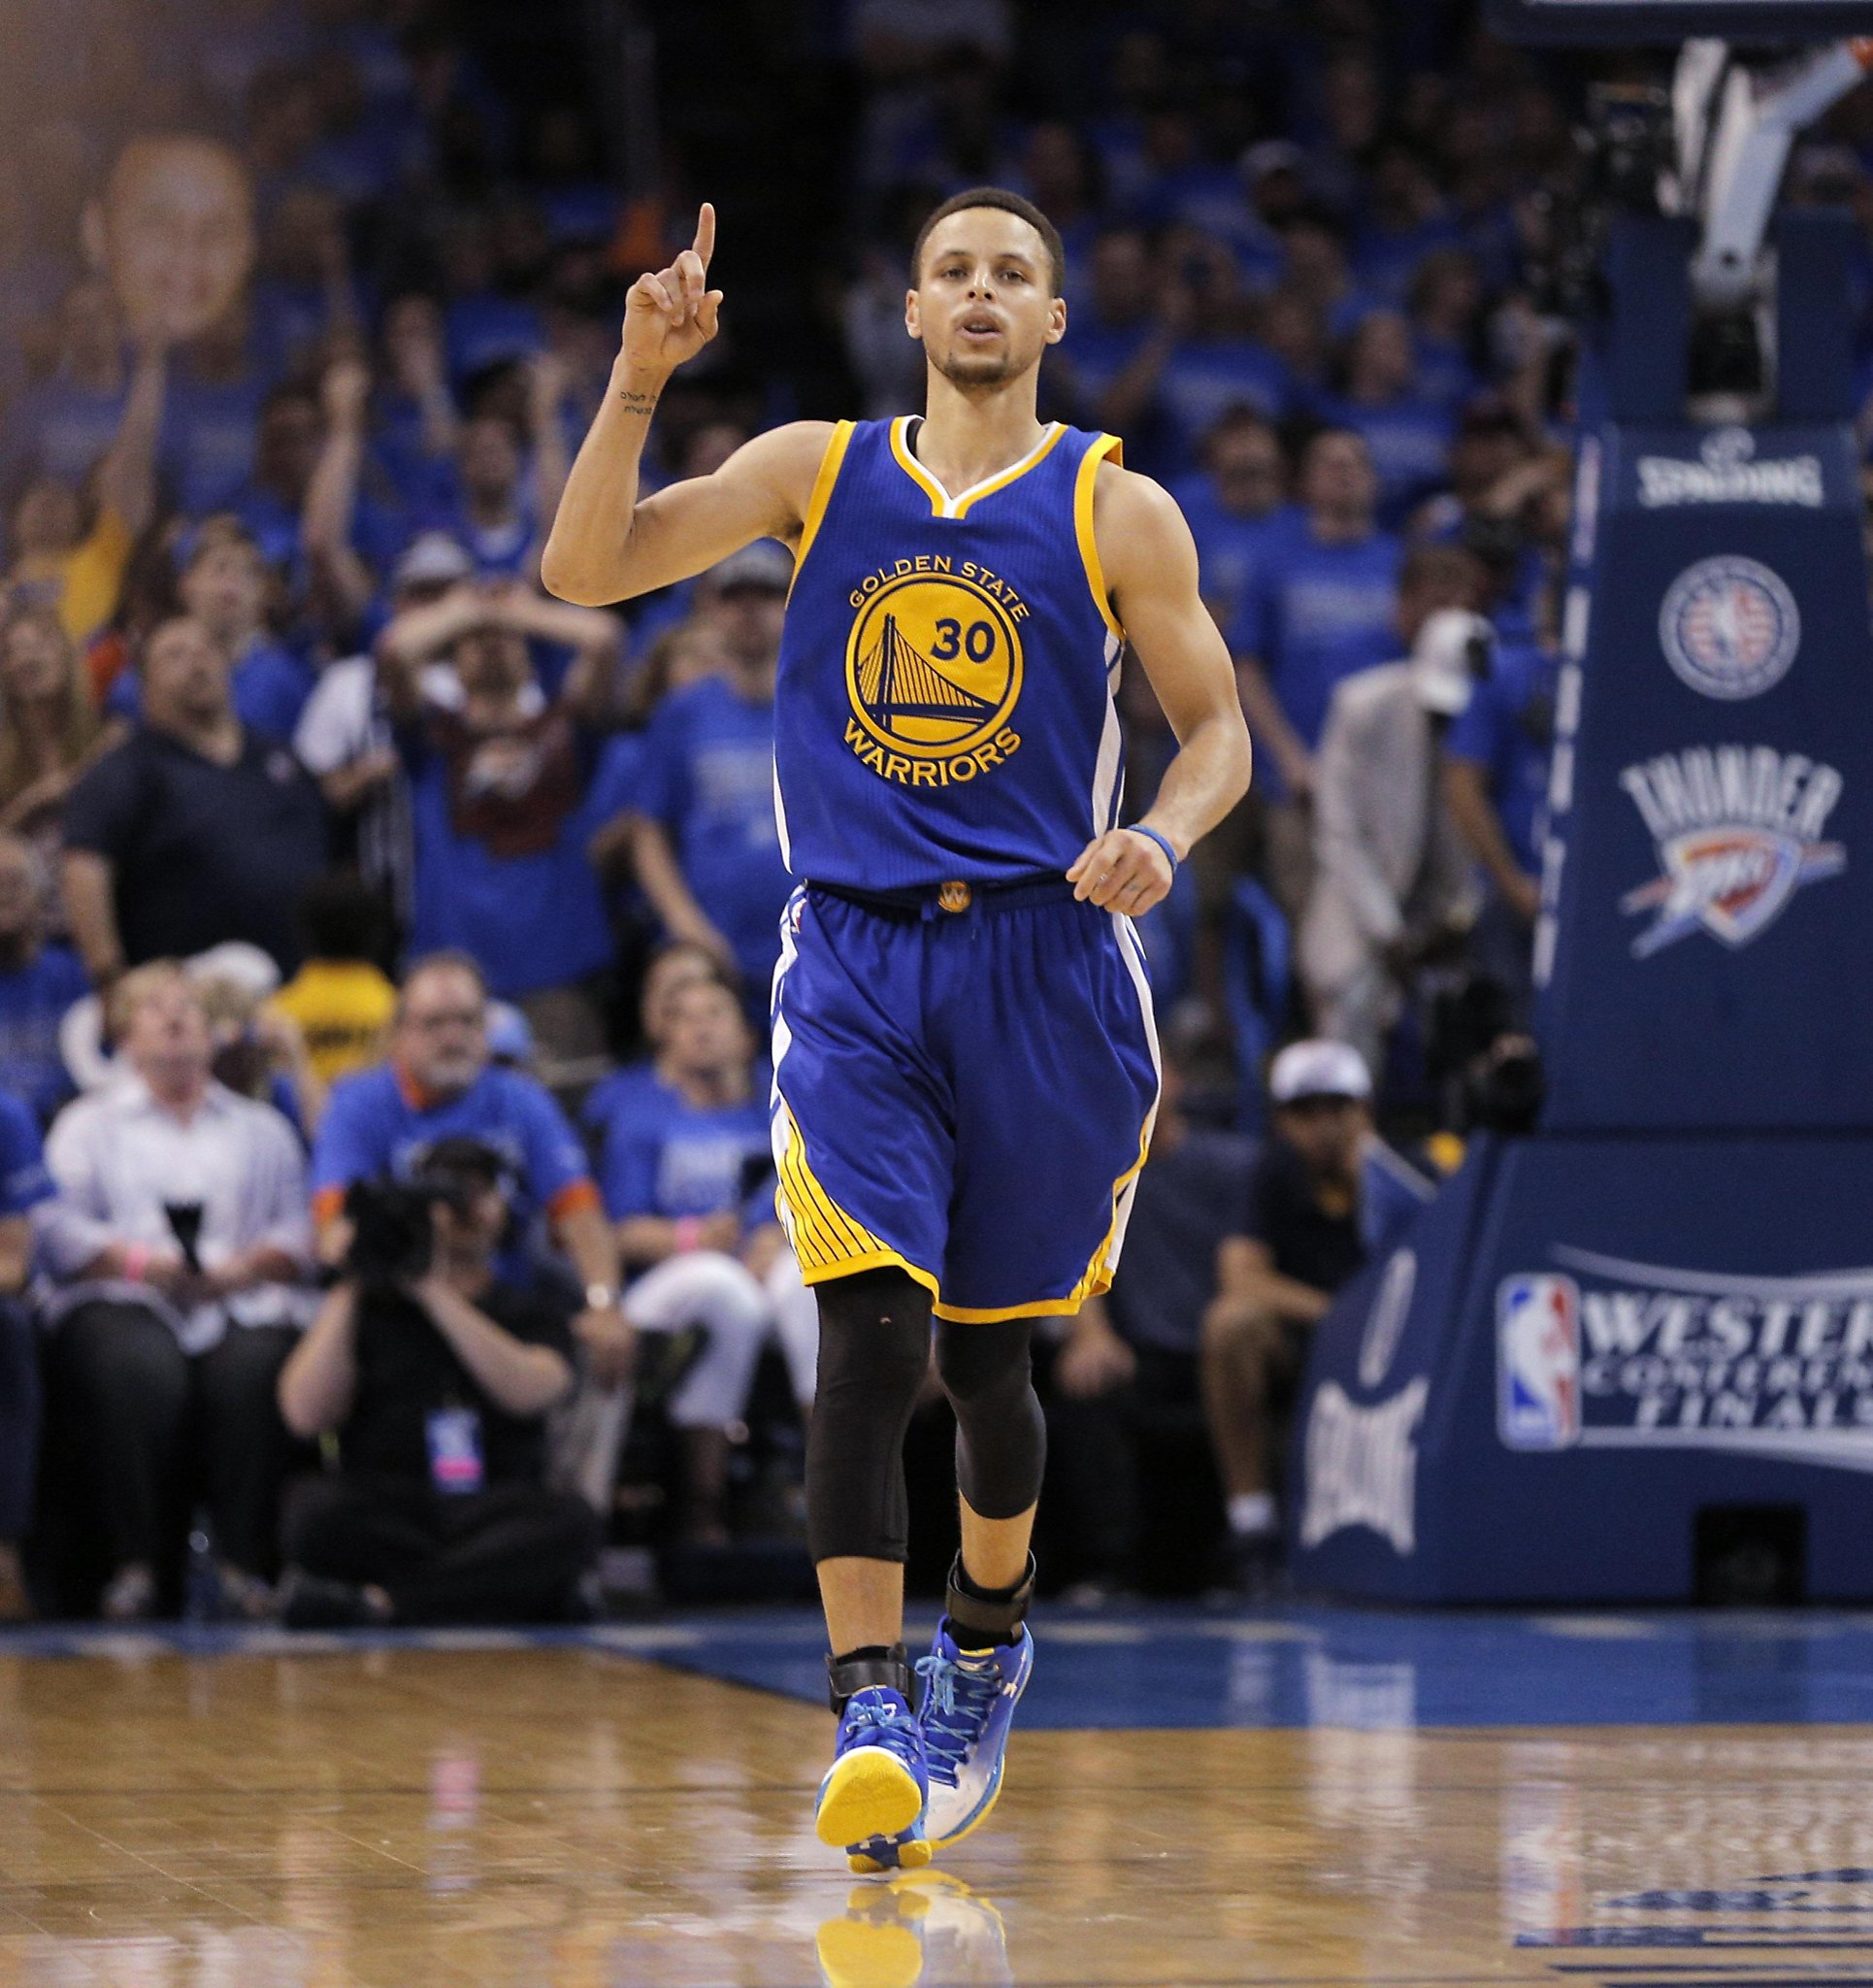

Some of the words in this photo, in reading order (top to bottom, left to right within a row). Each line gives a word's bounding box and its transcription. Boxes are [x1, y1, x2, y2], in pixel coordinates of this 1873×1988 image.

[848, 554, 952, 610] GOLDEN
[960, 560, 1031, 623] STATE
[931, 617, 996, 663] 30
[842, 715, 1022, 787] WARRIORS
[1618, 744, 1844, 843] THUNDER
